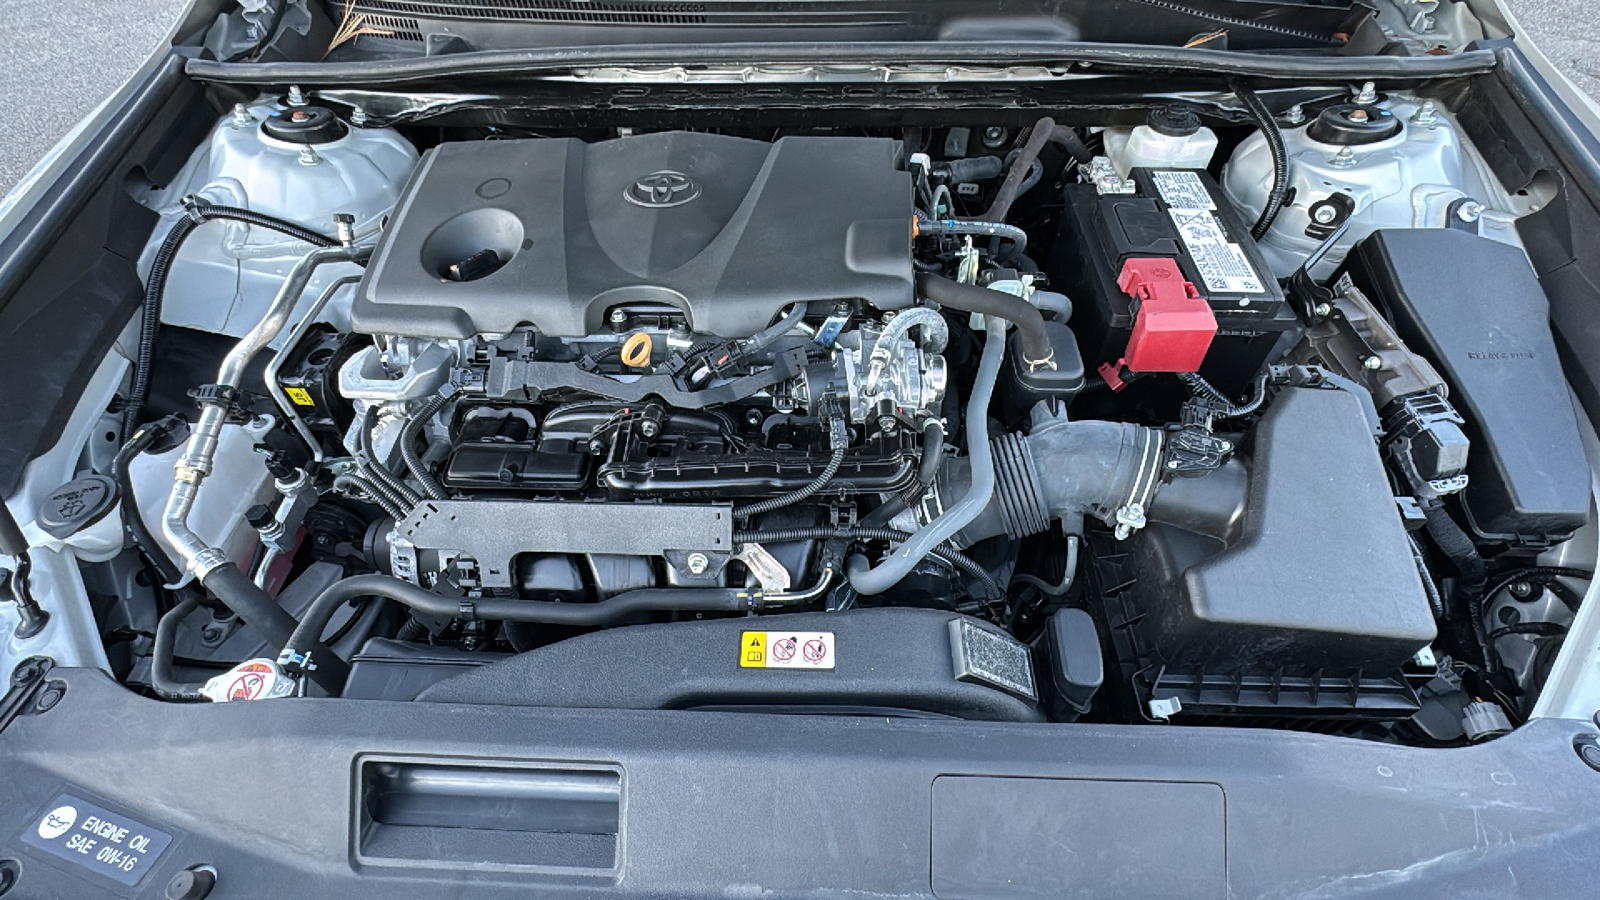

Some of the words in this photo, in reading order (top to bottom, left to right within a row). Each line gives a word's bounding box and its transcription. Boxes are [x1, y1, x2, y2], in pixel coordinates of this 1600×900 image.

[66, 834, 97, 854] SAE
[97, 846, 138, 871] 0W-16
[81, 815, 129, 843] ENGINE
[128, 835, 151, 854] OIL
